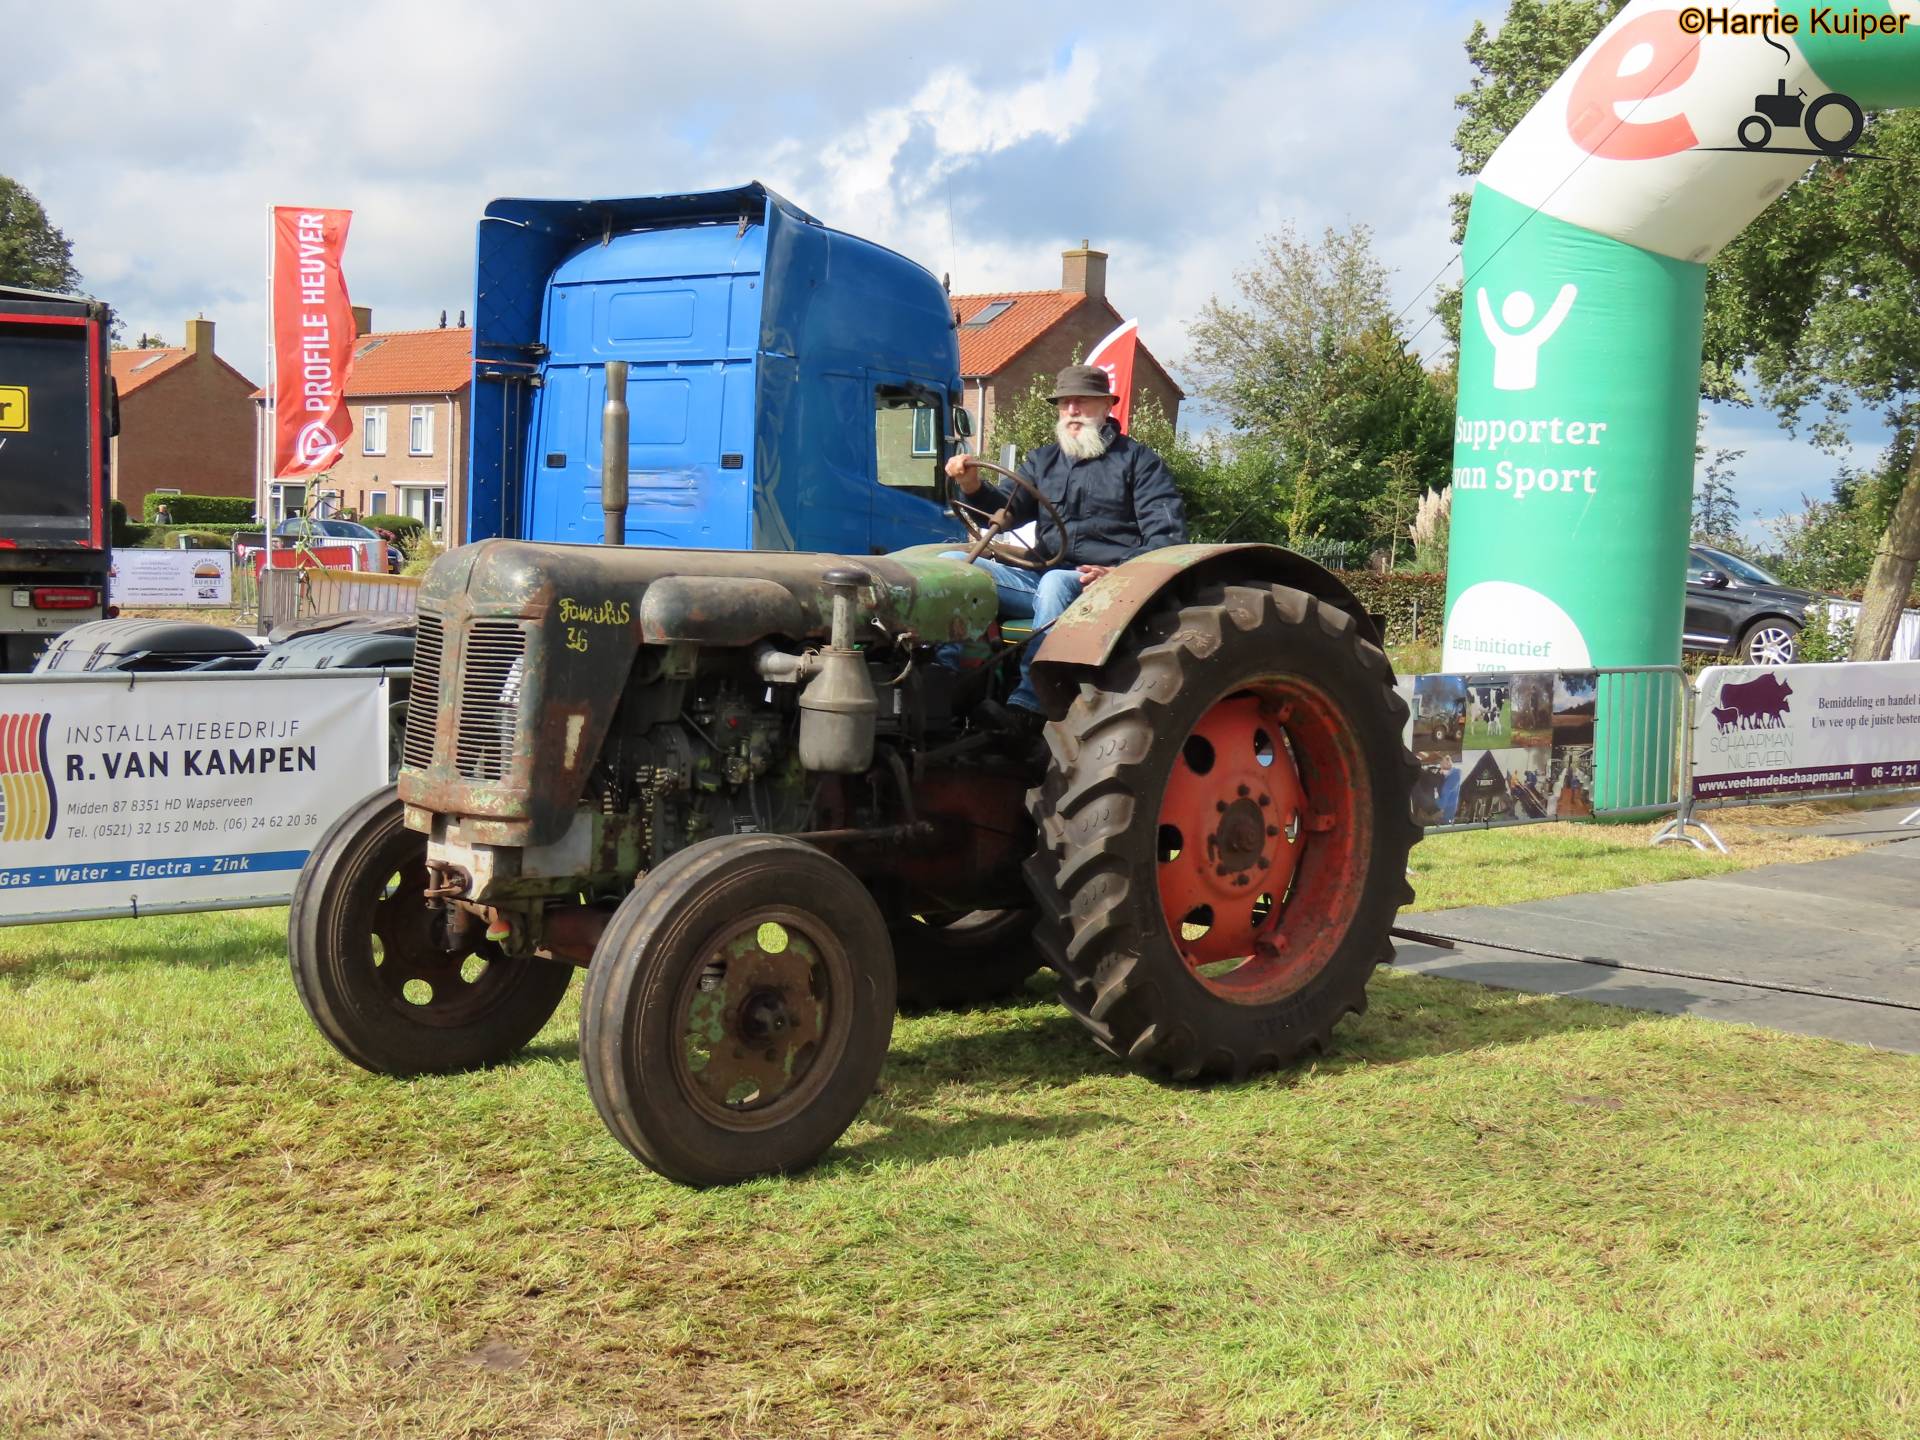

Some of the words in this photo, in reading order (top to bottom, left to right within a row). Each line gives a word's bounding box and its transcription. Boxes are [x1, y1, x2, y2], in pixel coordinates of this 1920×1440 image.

[299, 213, 326, 304] HEUVER
[303, 314, 332, 411] PROFILE
[1456, 416, 1606, 450] Supporter
[1455, 466, 1486, 489] van
[1495, 460, 1597, 498] Sport
[1452, 634, 1471, 651] Een
[1474, 636, 1552, 657] initiatief
[1818, 695, 1873, 710] Bemiddeling
[1875, 697, 1885, 706] en
[1888, 693, 1916, 706] handel
[66, 720, 300, 744] INSTALLATIEBEDRIJF
[1812, 716, 1826, 729] Uw
[1829, 718, 1843, 727] vee
[1845, 717, 1856, 730] op
[1858, 714, 1869, 726] de
[1870, 713, 1894, 728] juiste
[1710, 731, 1793, 753] SCHAAPMAN
[102, 750, 169, 779] VAN
[184, 746, 317, 777] KAMPEN
[1871, 767, 1884, 778] 06
[1891, 765, 1903, 777] 21
[1905, 764, 1917, 776] 21
[1698, 768, 1854, 792] www.veehandelschaapman.nl
[67, 803, 108, 815] Midden
[112, 801, 127, 813] 87
[130, 799, 160, 812] 8351
[164, 798, 182, 810] HD
[186, 797, 253, 811] Wapserveen
[67, 826, 88, 838] Tel.
[93, 823, 132, 839] (0521)
[137, 822, 152, 835] 32
[156, 821, 170, 833] 15
[174, 820, 189, 833] 20
[193, 819, 218, 831] Mob.
[223, 817, 247, 832] (06)
[251, 816, 265, 828] 24
[269, 815, 283, 828] 62
[287, 814, 301, 827] 20
[304, 814, 318, 826] 36
[0, 872, 31, 886] Gas
[54, 867, 109, 883] Water
[129, 861, 192, 878] Electra
[212, 857, 250, 873] Zink
